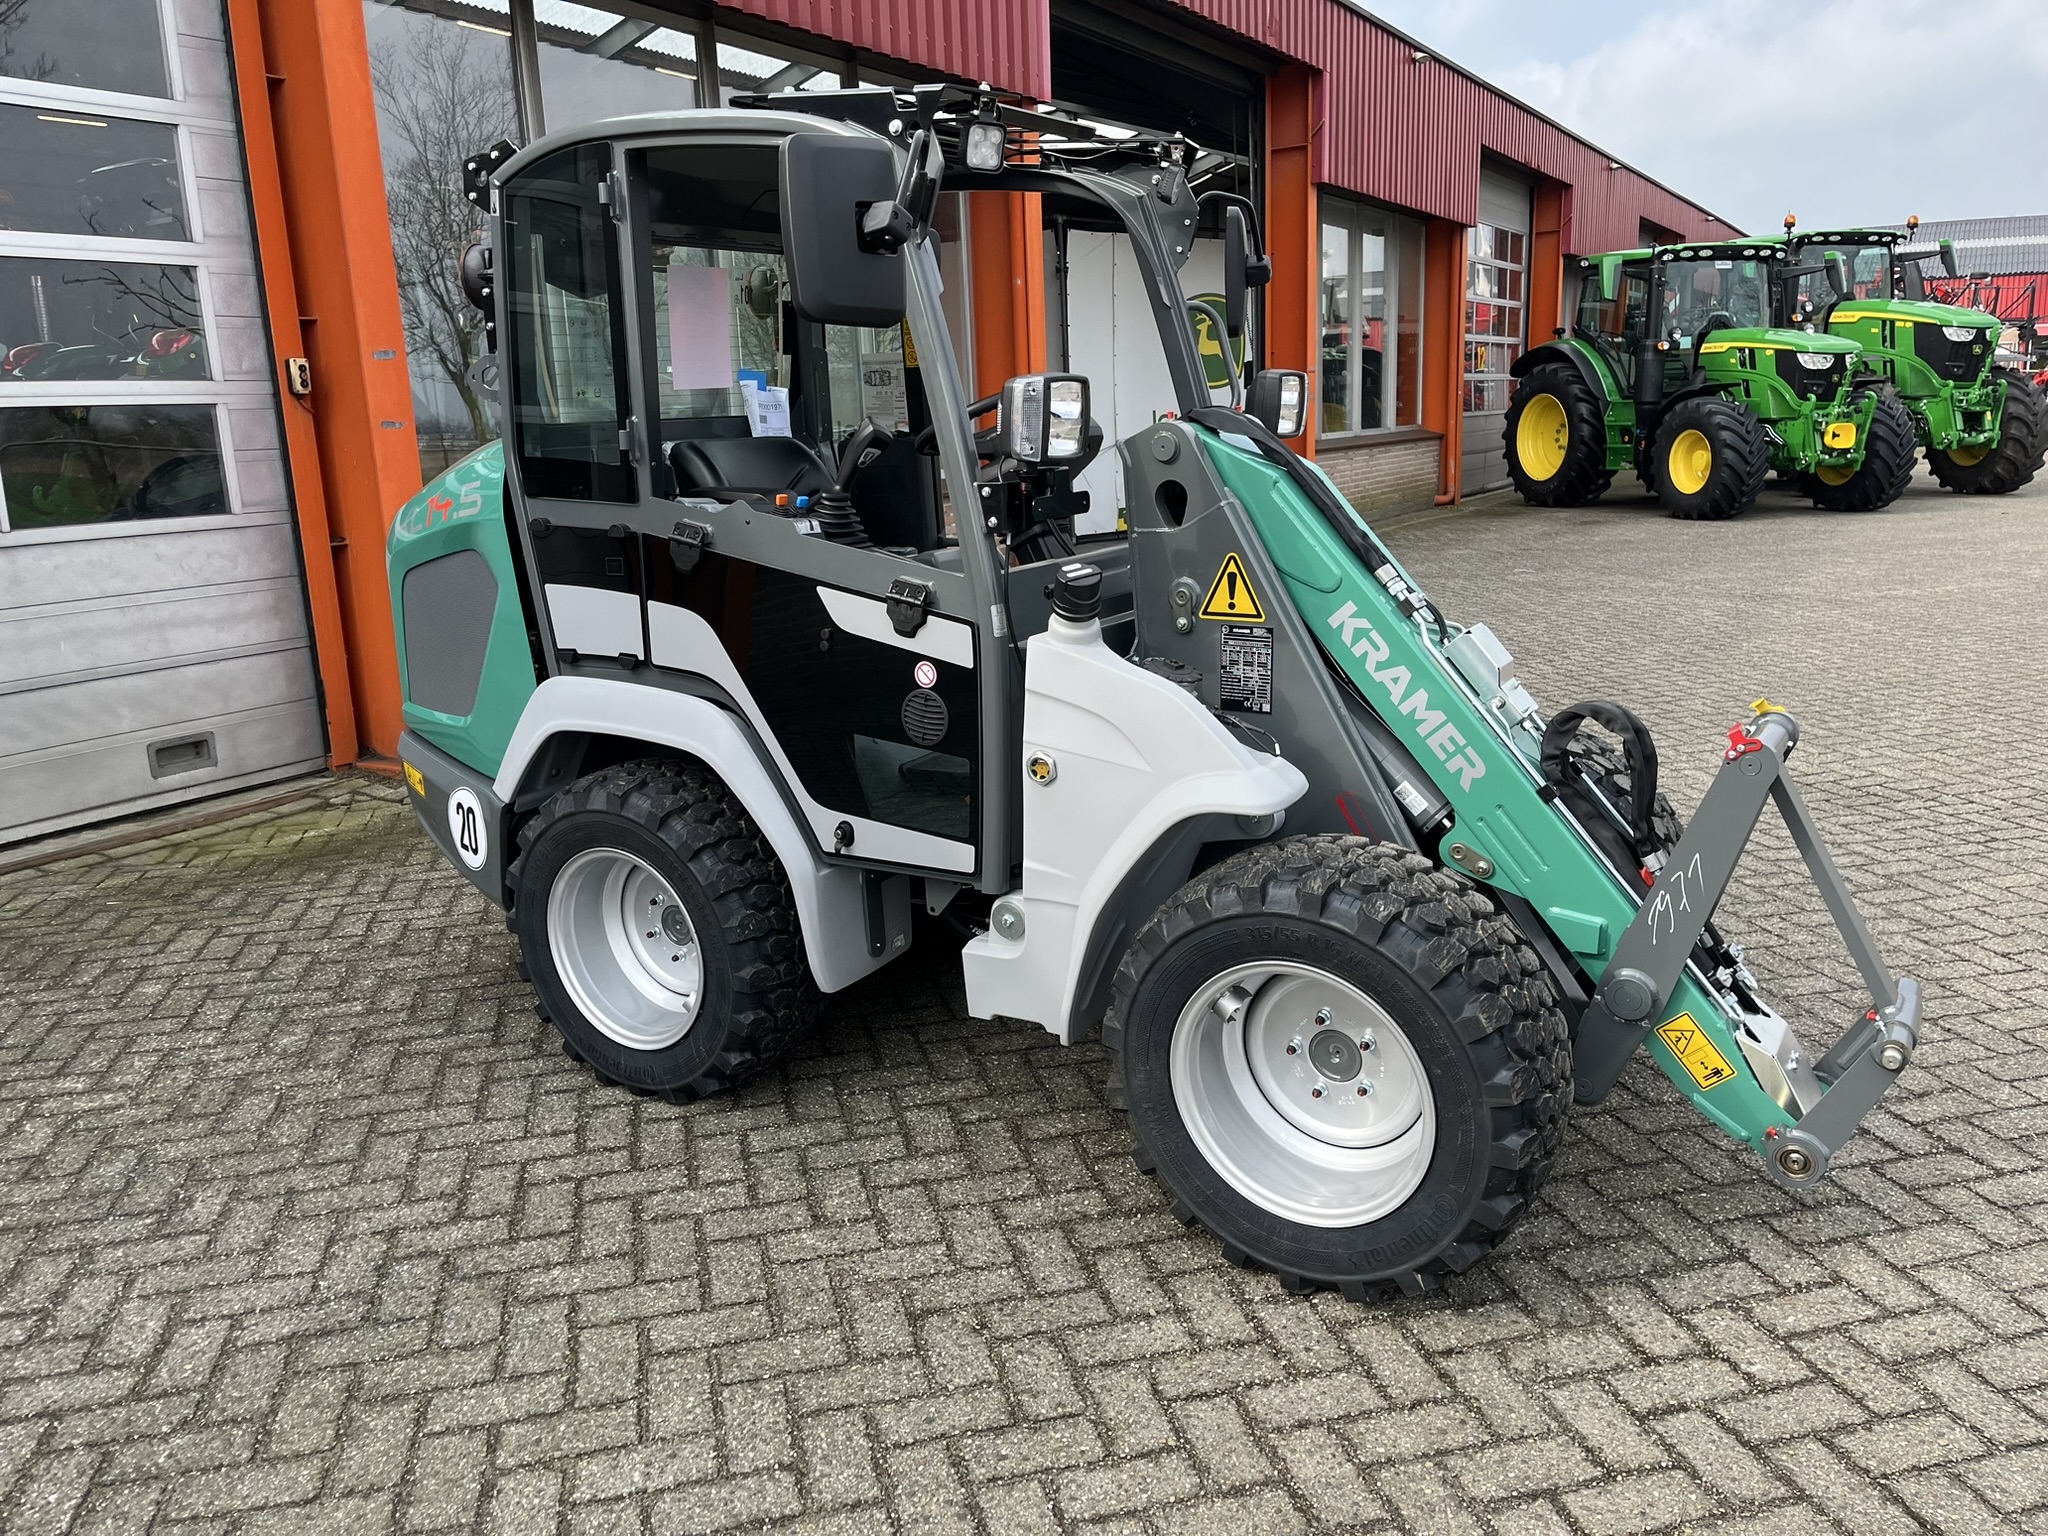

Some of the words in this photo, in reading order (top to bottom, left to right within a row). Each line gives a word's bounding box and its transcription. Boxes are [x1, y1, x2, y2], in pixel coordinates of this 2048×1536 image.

[1328, 600, 1486, 793] KRAMER
[456, 801, 479, 856] 20
[1363, 1193, 1459, 1267] Continental
